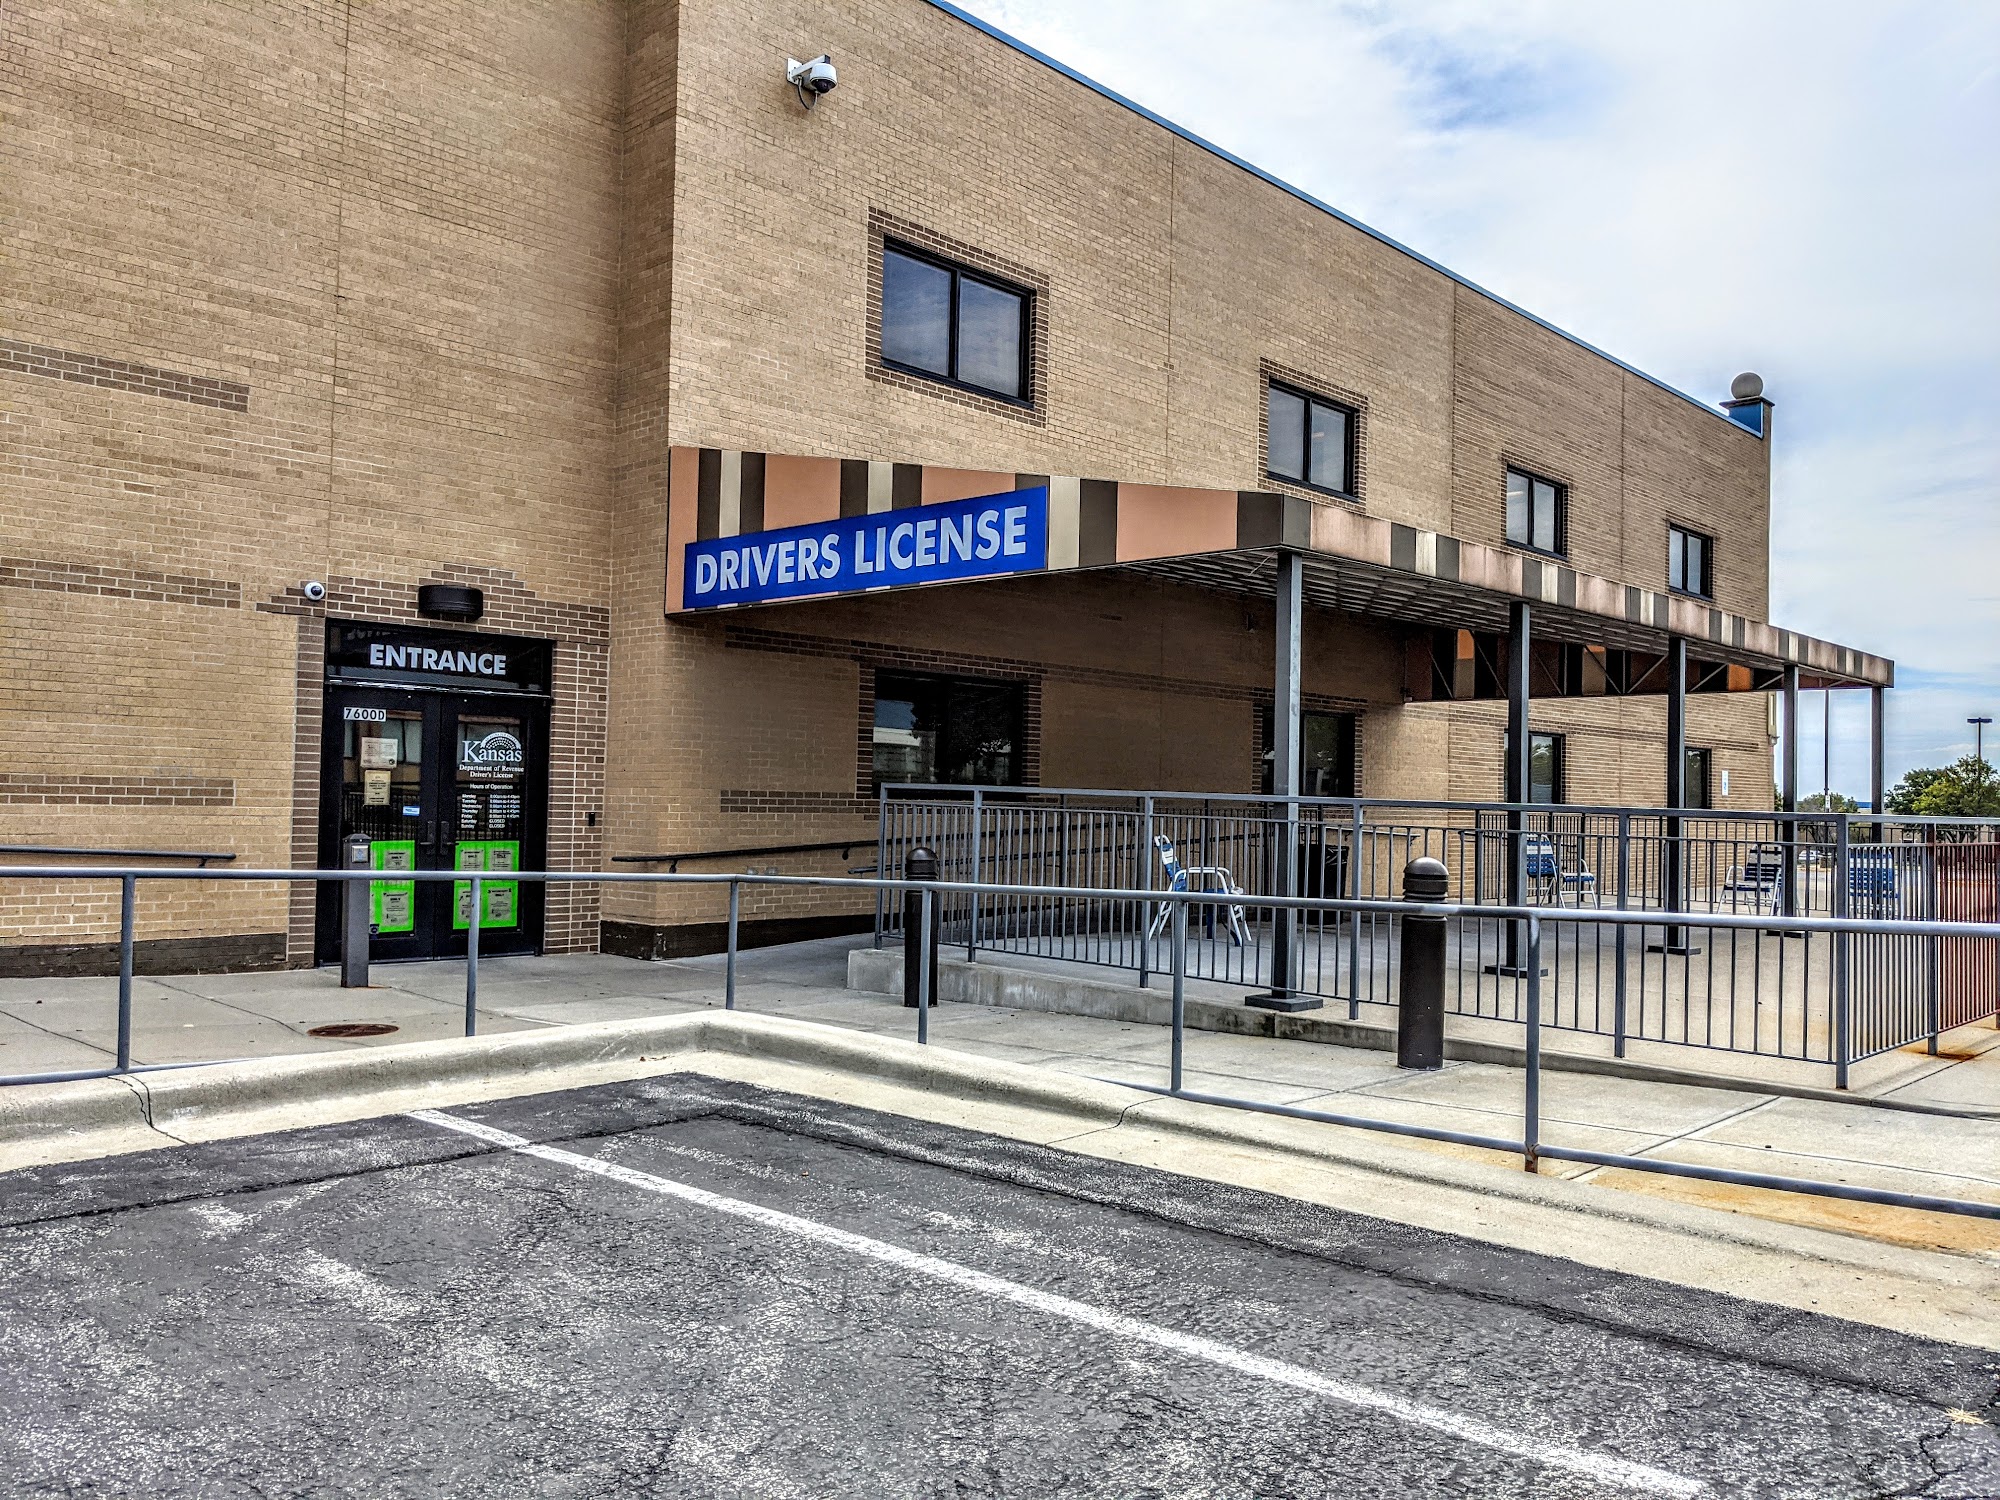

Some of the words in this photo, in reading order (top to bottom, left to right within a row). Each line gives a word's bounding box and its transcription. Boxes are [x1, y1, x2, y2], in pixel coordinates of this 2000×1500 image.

[695, 533, 841, 595] DRIVERS
[854, 505, 1027, 575] LICENSE
[369, 643, 506, 676] ENTRANCE
[345, 708, 385, 720] 7600D
[461, 740, 522, 763] Kansas
[459, 764, 492, 772] Department
